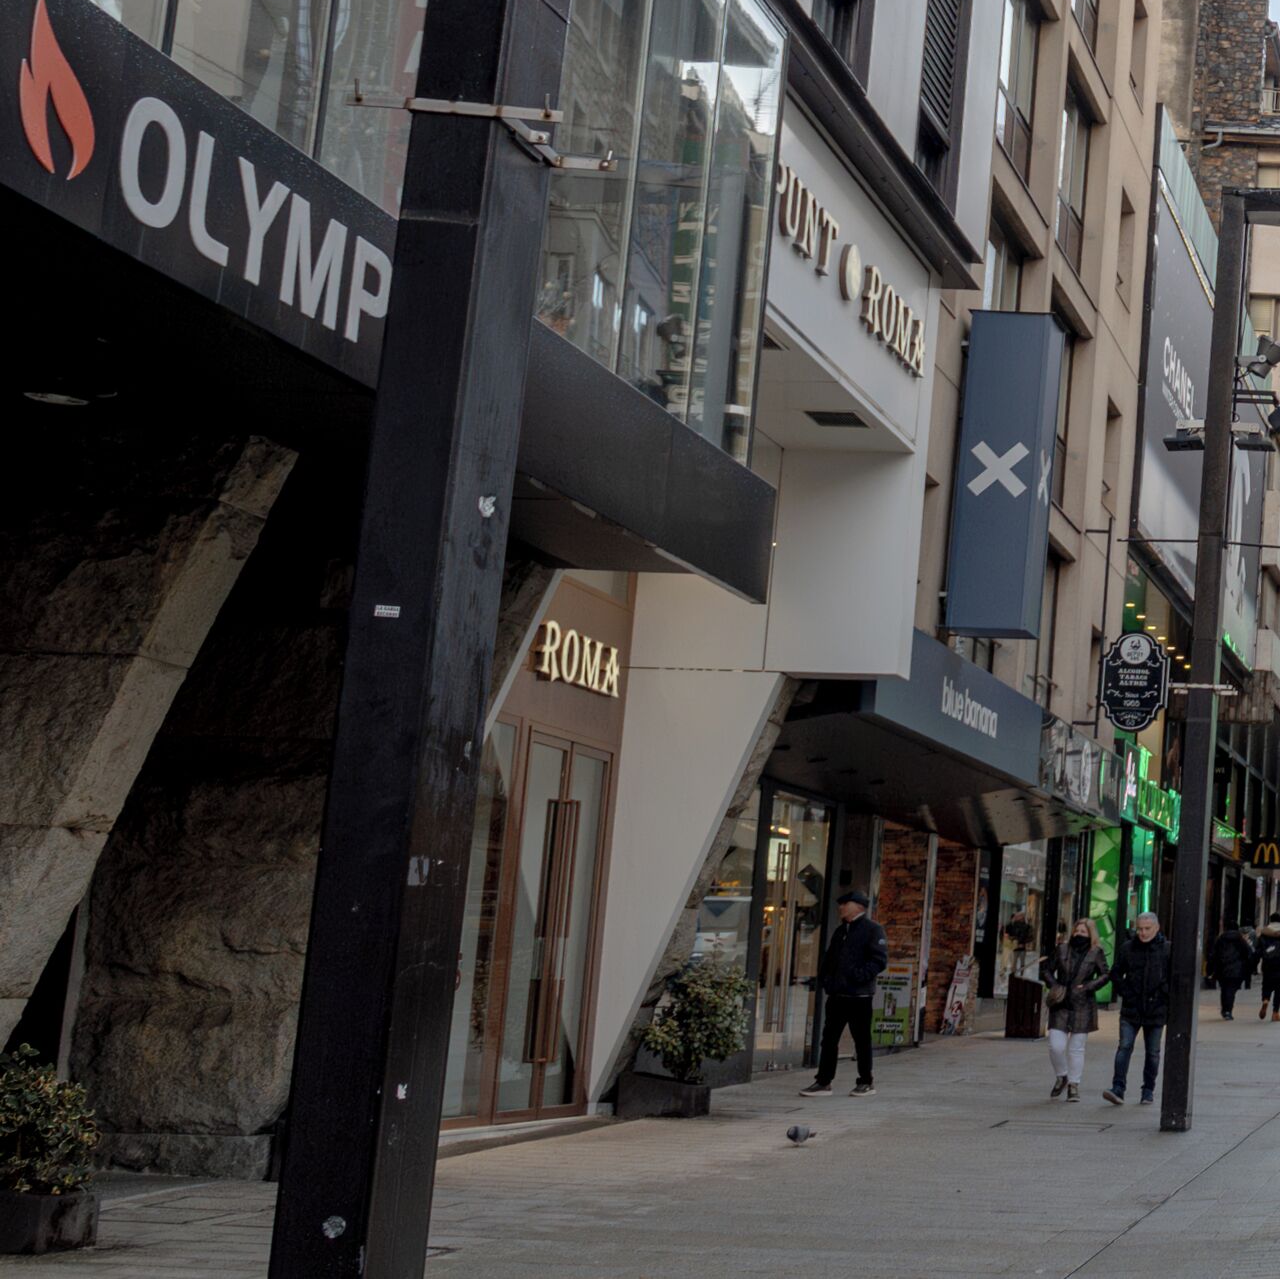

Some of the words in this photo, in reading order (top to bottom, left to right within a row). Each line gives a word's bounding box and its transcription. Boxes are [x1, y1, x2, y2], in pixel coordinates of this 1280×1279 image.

[860, 265, 924, 378] ROMA
[1163, 335, 1195, 420] CHANEL
[541, 620, 620, 698] ROMA
[941, 675, 965, 722] blue
[964, 687, 999, 739] banana
